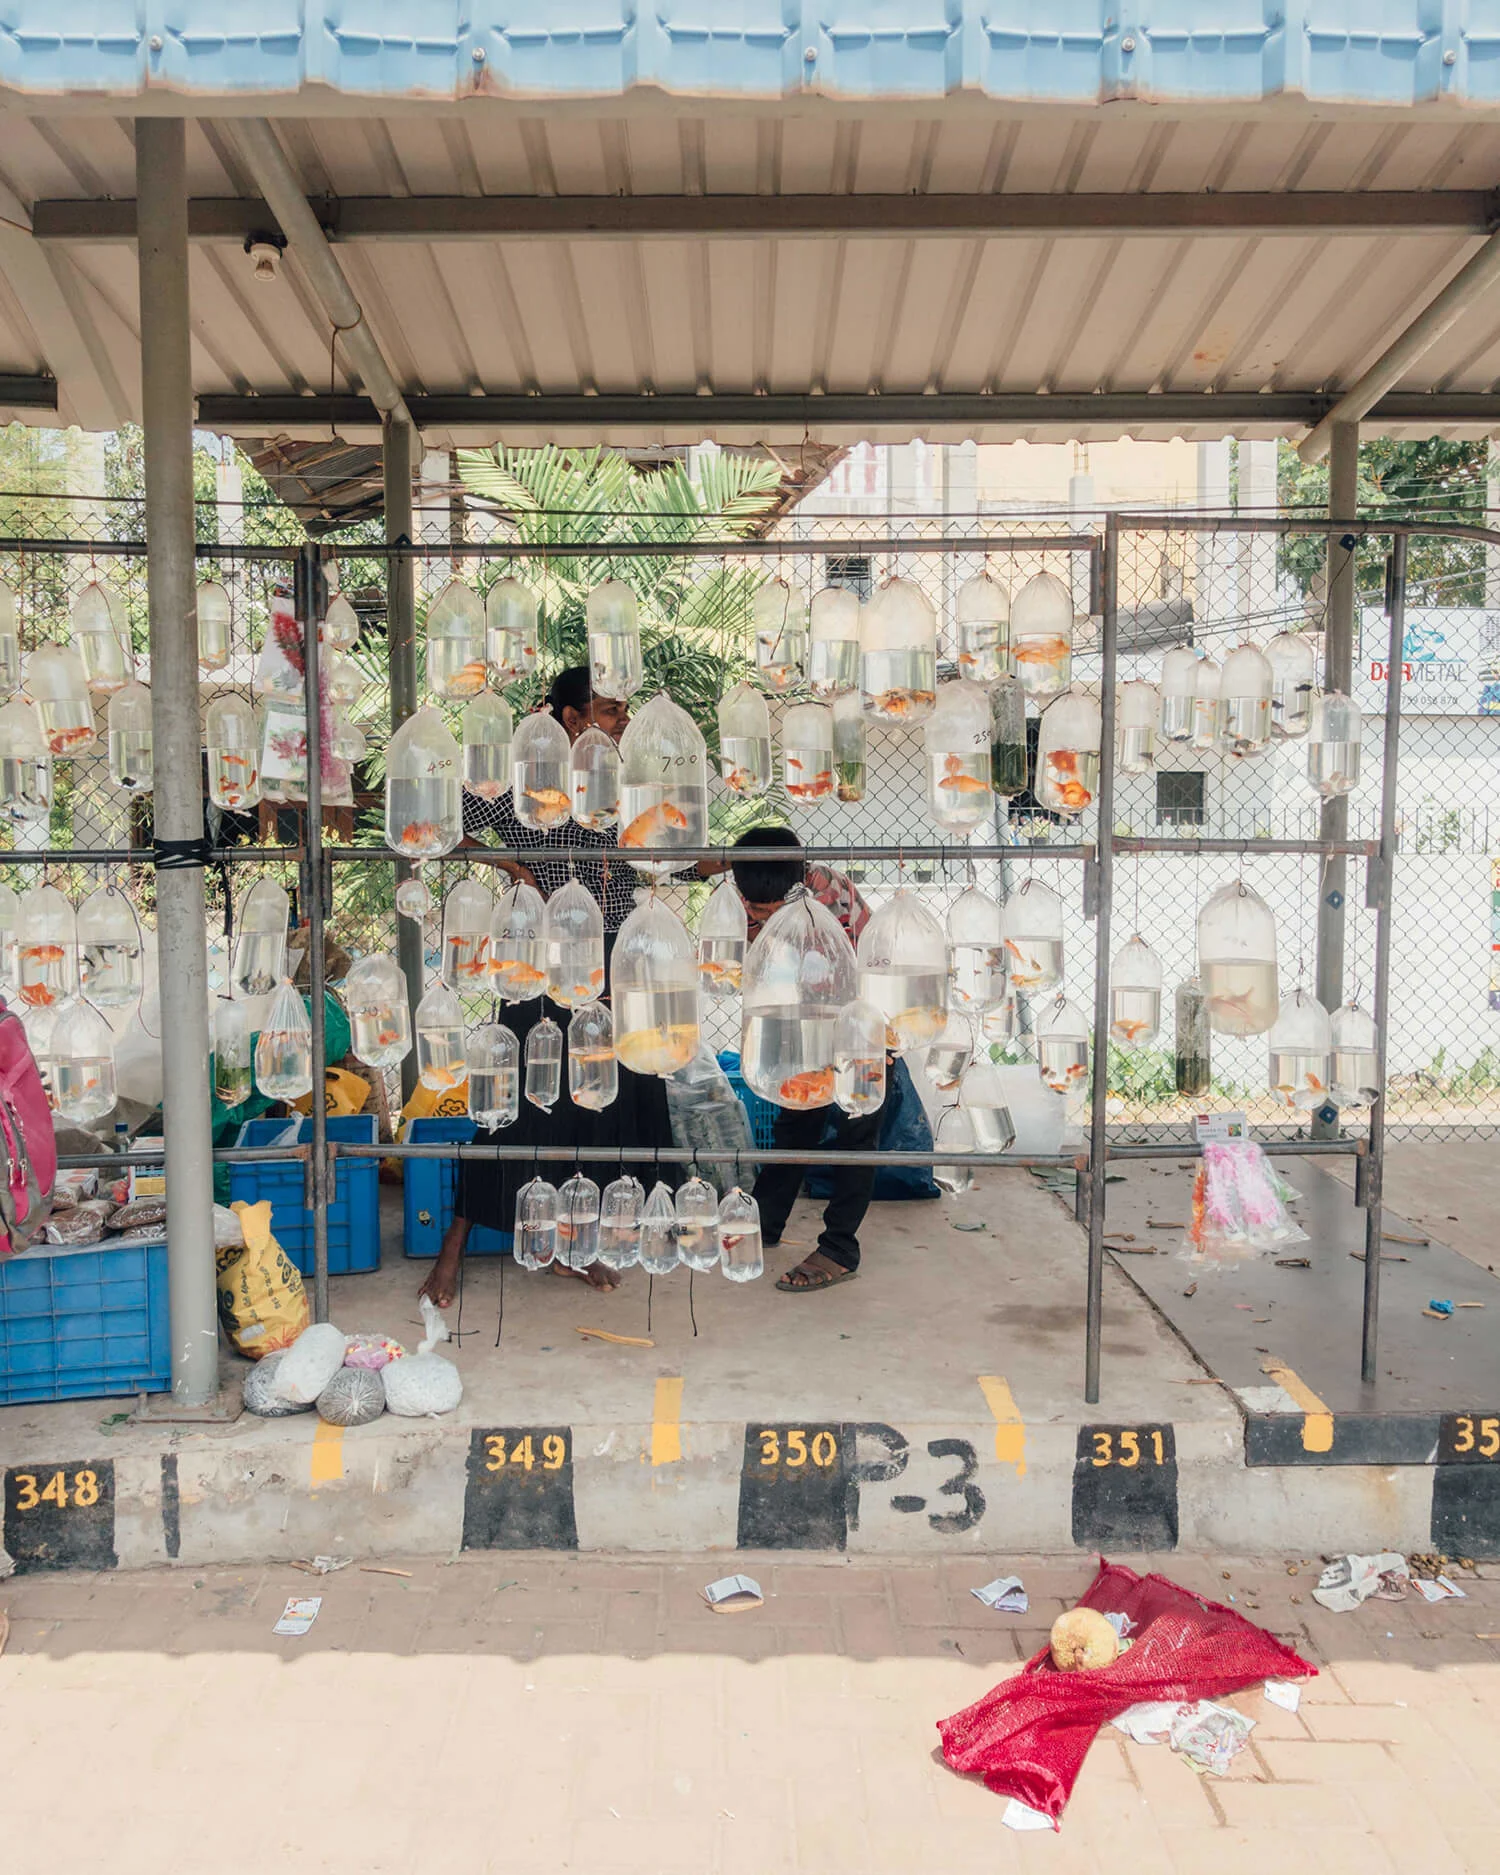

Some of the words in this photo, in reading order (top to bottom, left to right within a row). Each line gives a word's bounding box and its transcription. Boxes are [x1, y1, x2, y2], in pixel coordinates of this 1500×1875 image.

[427, 759, 452, 776] 450
[662, 754, 698, 773] 700
[485, 1434, 566, 1472] 349
[759, 1430, 837, 1467] 350
[1092, 1430, 1164, 1467] 351
[14, 1469, 99, 1511] 348
